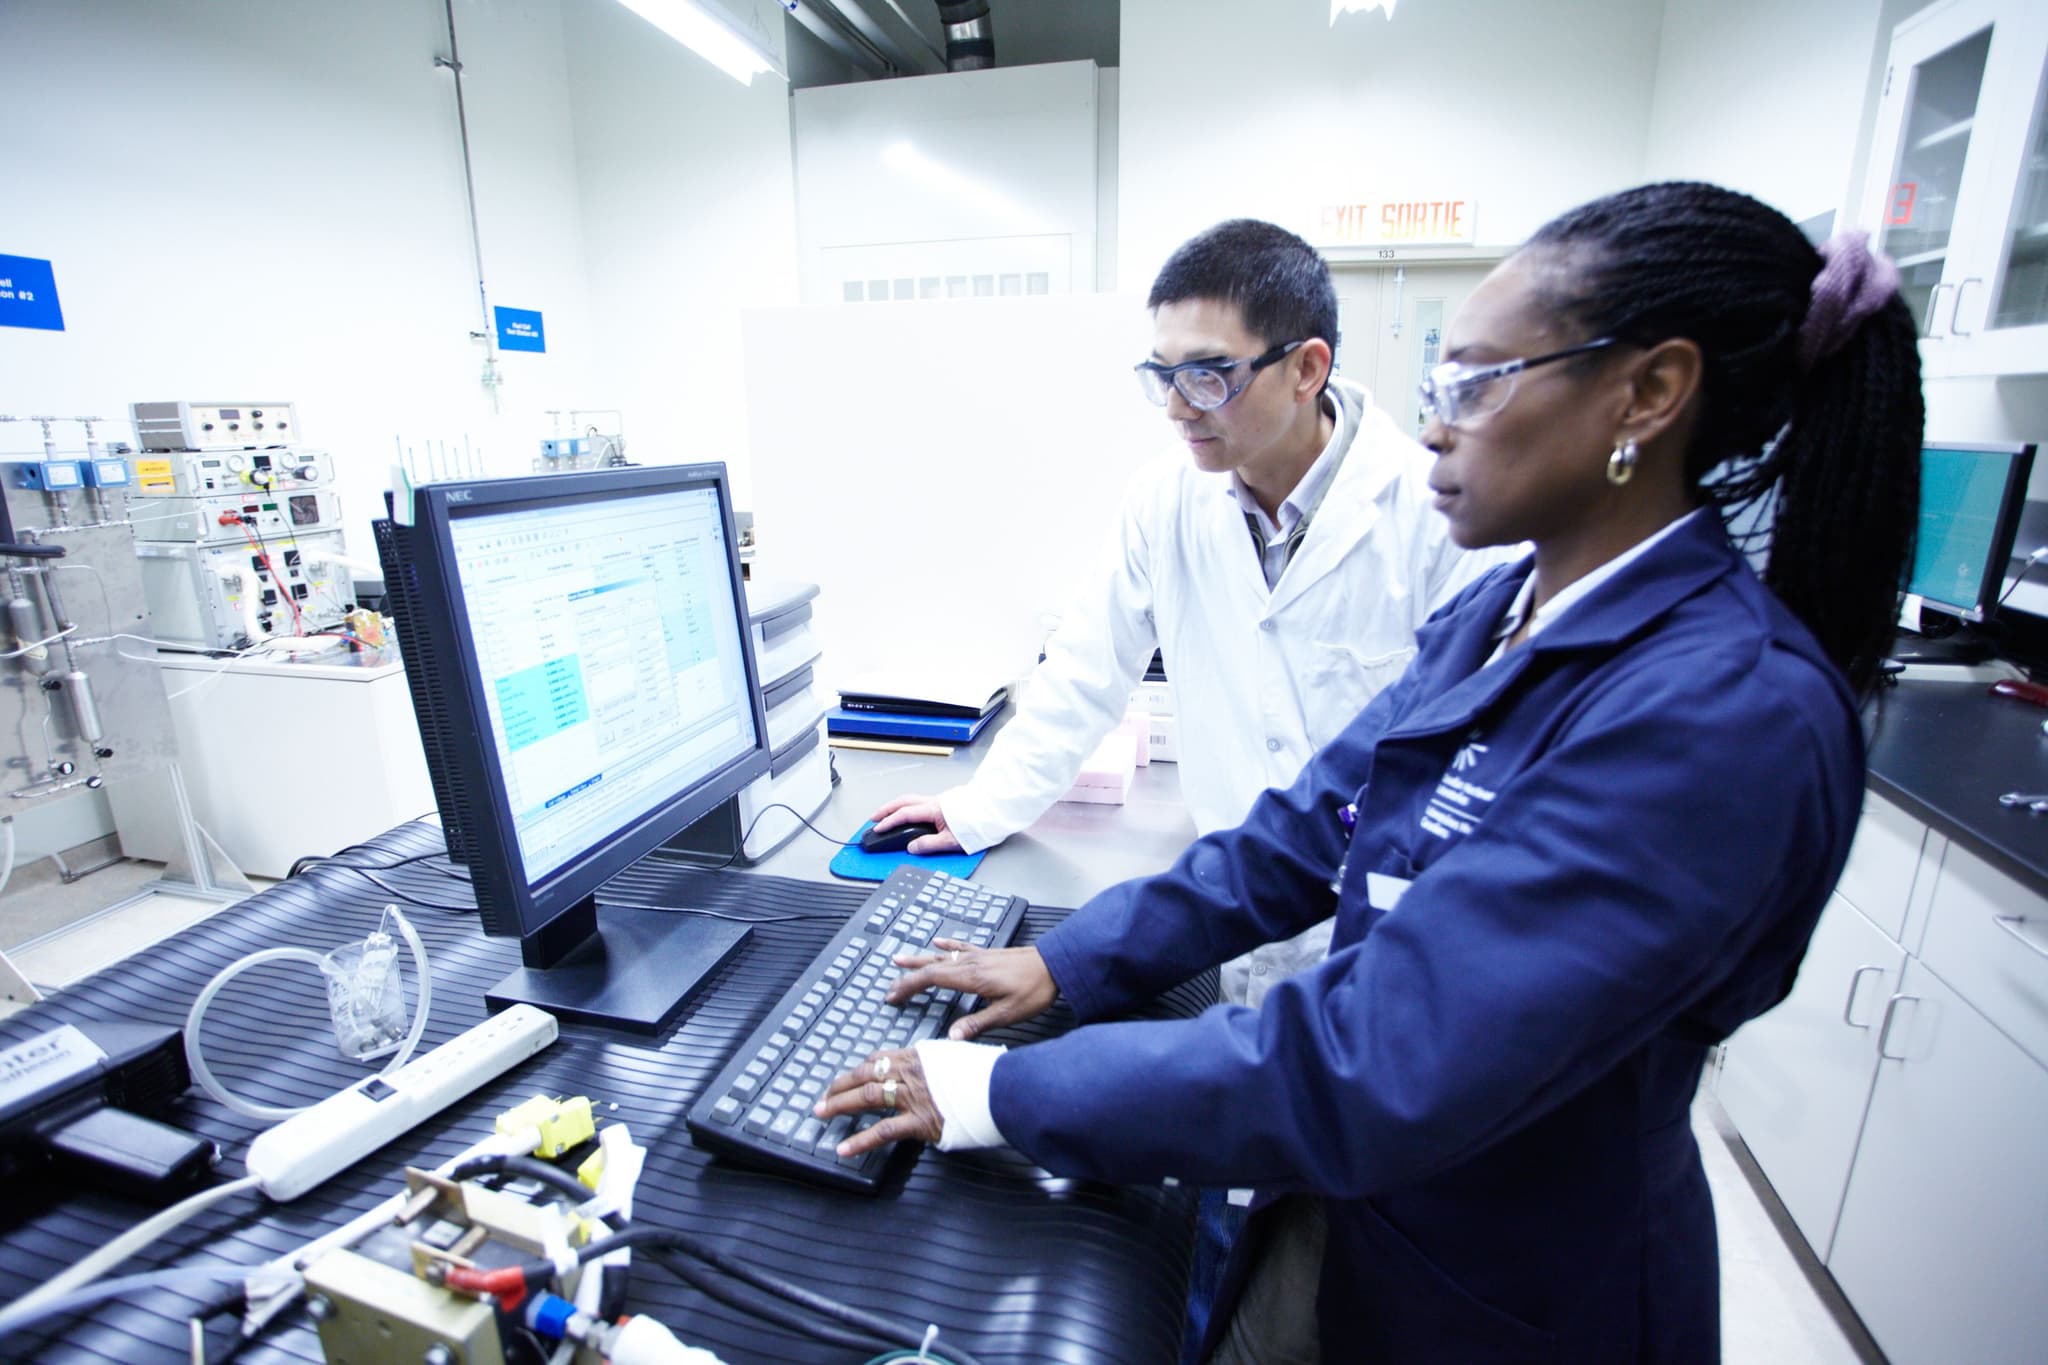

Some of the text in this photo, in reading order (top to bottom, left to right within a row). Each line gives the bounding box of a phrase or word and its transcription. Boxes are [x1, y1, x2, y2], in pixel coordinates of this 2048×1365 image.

[1381, 201, 1465, 239] SORTIE
[1379, 250, 1395, 259] 133
[445, 490, 473, 503] NEC
